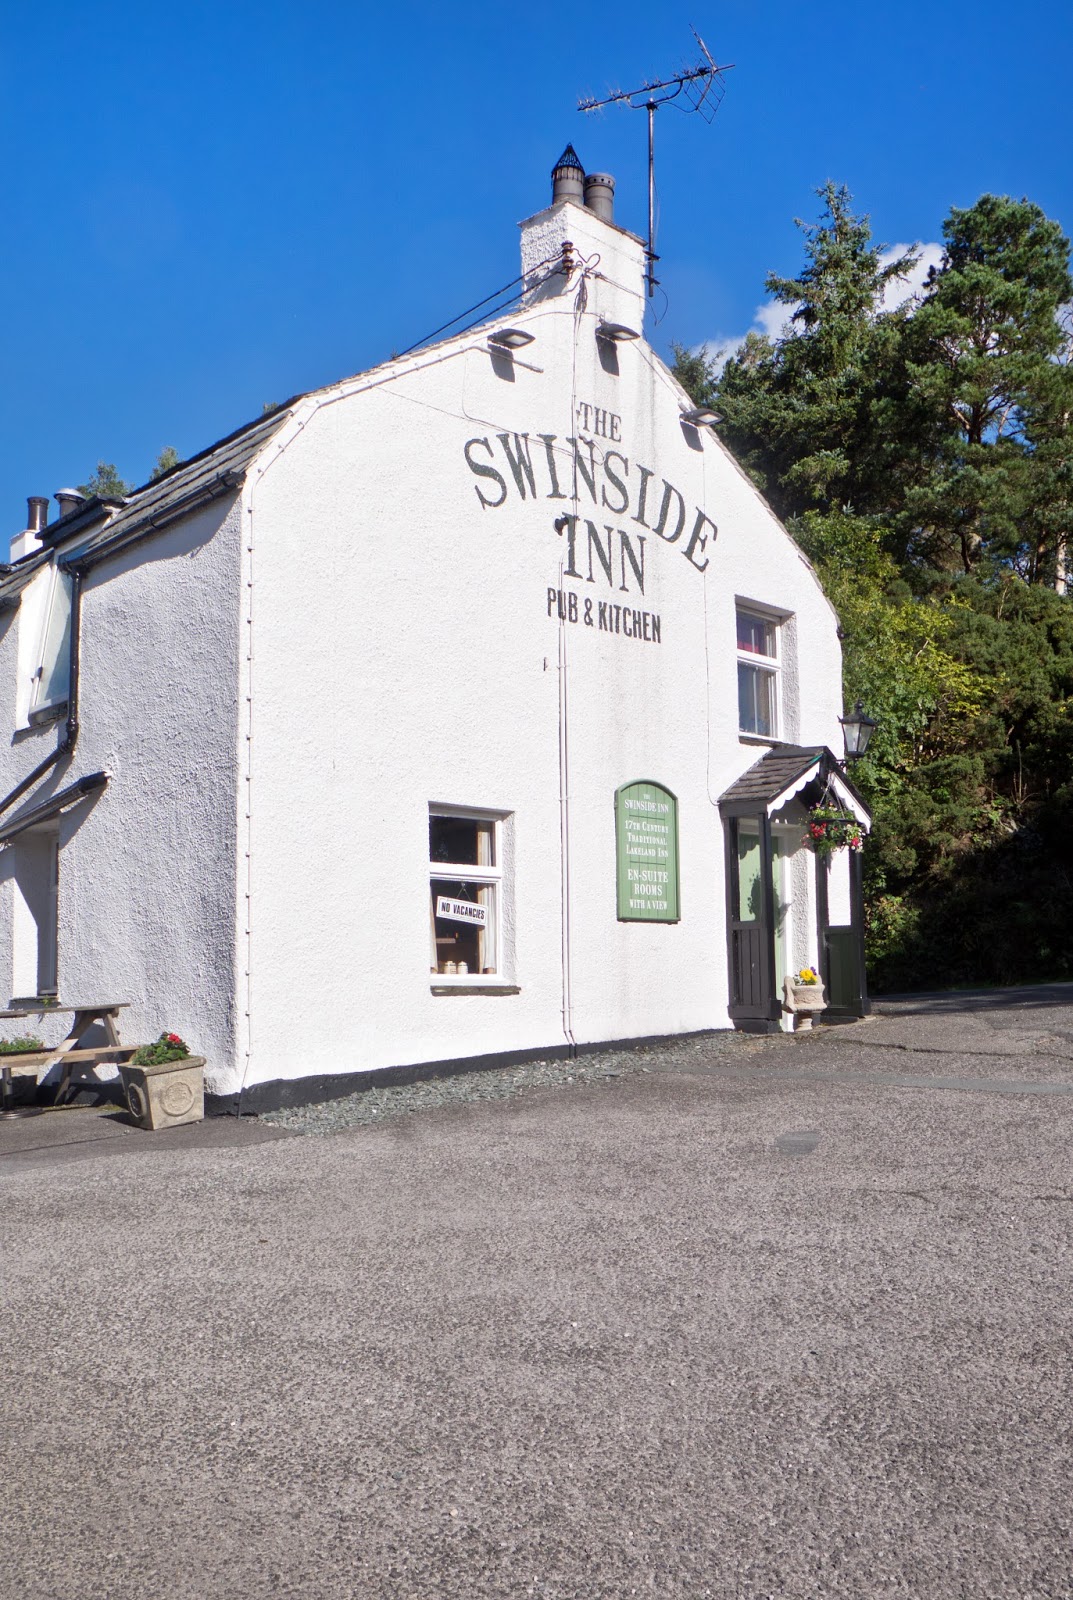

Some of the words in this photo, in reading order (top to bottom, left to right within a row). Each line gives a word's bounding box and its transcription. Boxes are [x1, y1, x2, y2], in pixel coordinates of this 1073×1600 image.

[579, 401, 622, 443] THE
[464, 432, 718, 573] SWINSIDE
[562, 512, 647, 597] INN
[547, 587, 578, 624] PUB
[584, 597, 594, 627] &
[598, 600, 662, 644] KITCHEN
[624, 799, 657, 812] SWINSIDE
[657, 803, 669, 814] INN
[627, 868, 669, 883] EN-SUITE
[634, 883, 663, 896] ROOMS
[441, 901, 451, 913] NO
[453, 904, 485, 920] VACANCIES
[629, 899, 646, 909] WITH
[646, 900, 652, 910] A
[652, 900, 668, 910] VIEW
